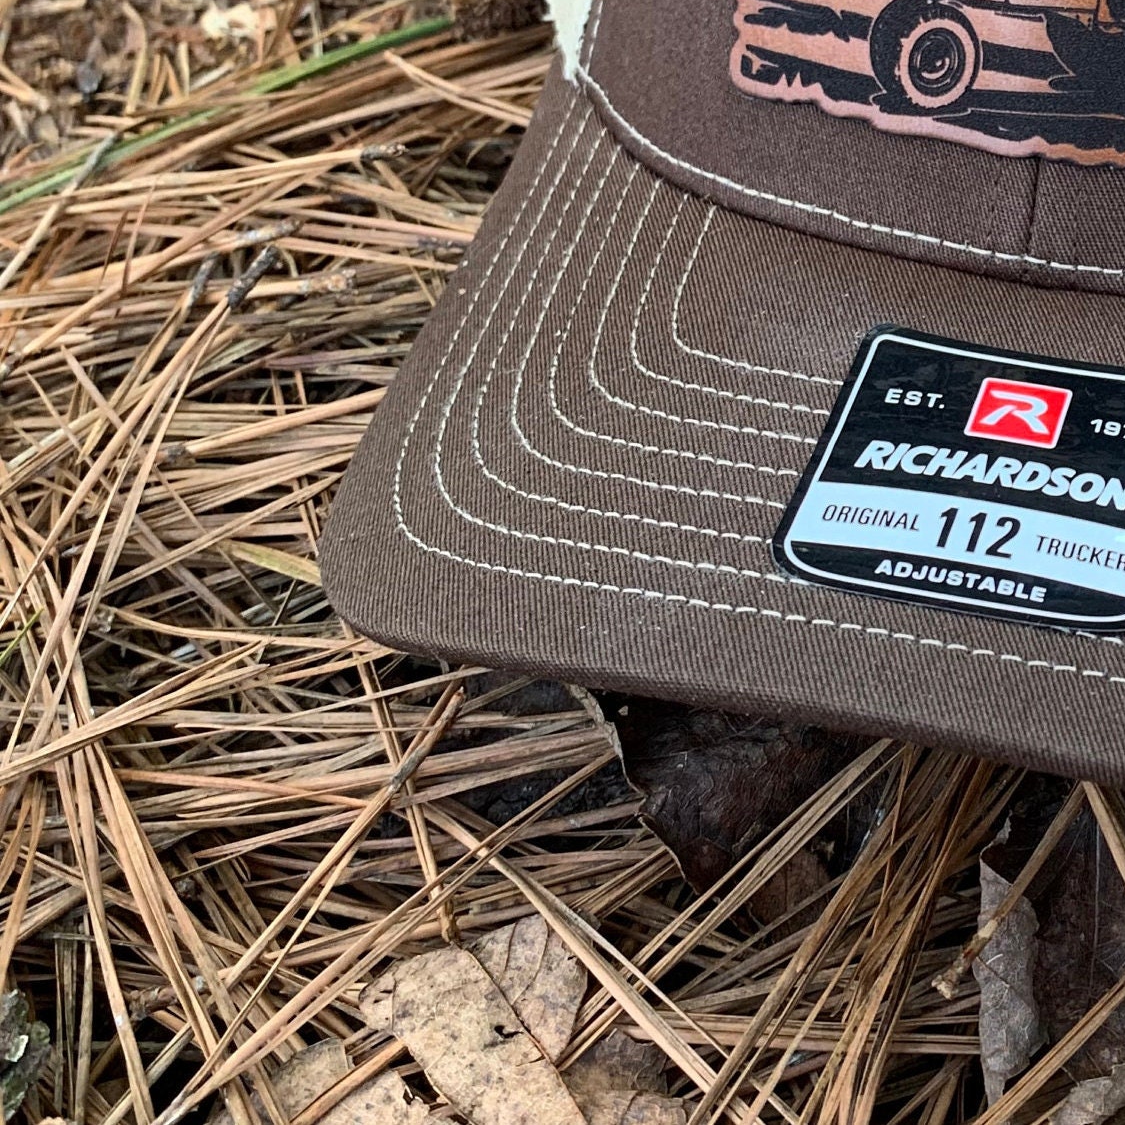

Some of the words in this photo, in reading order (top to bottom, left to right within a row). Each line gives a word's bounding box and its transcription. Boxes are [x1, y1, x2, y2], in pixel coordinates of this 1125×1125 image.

[884, 387, 945, 409] EST.
[979, 389, 1051, 436] R
[822, 504, 920, 531] ORIGINAL
[935, 507, 1021, 559] 112
[874, 559, 1047, 603] ADJUSTABLE
